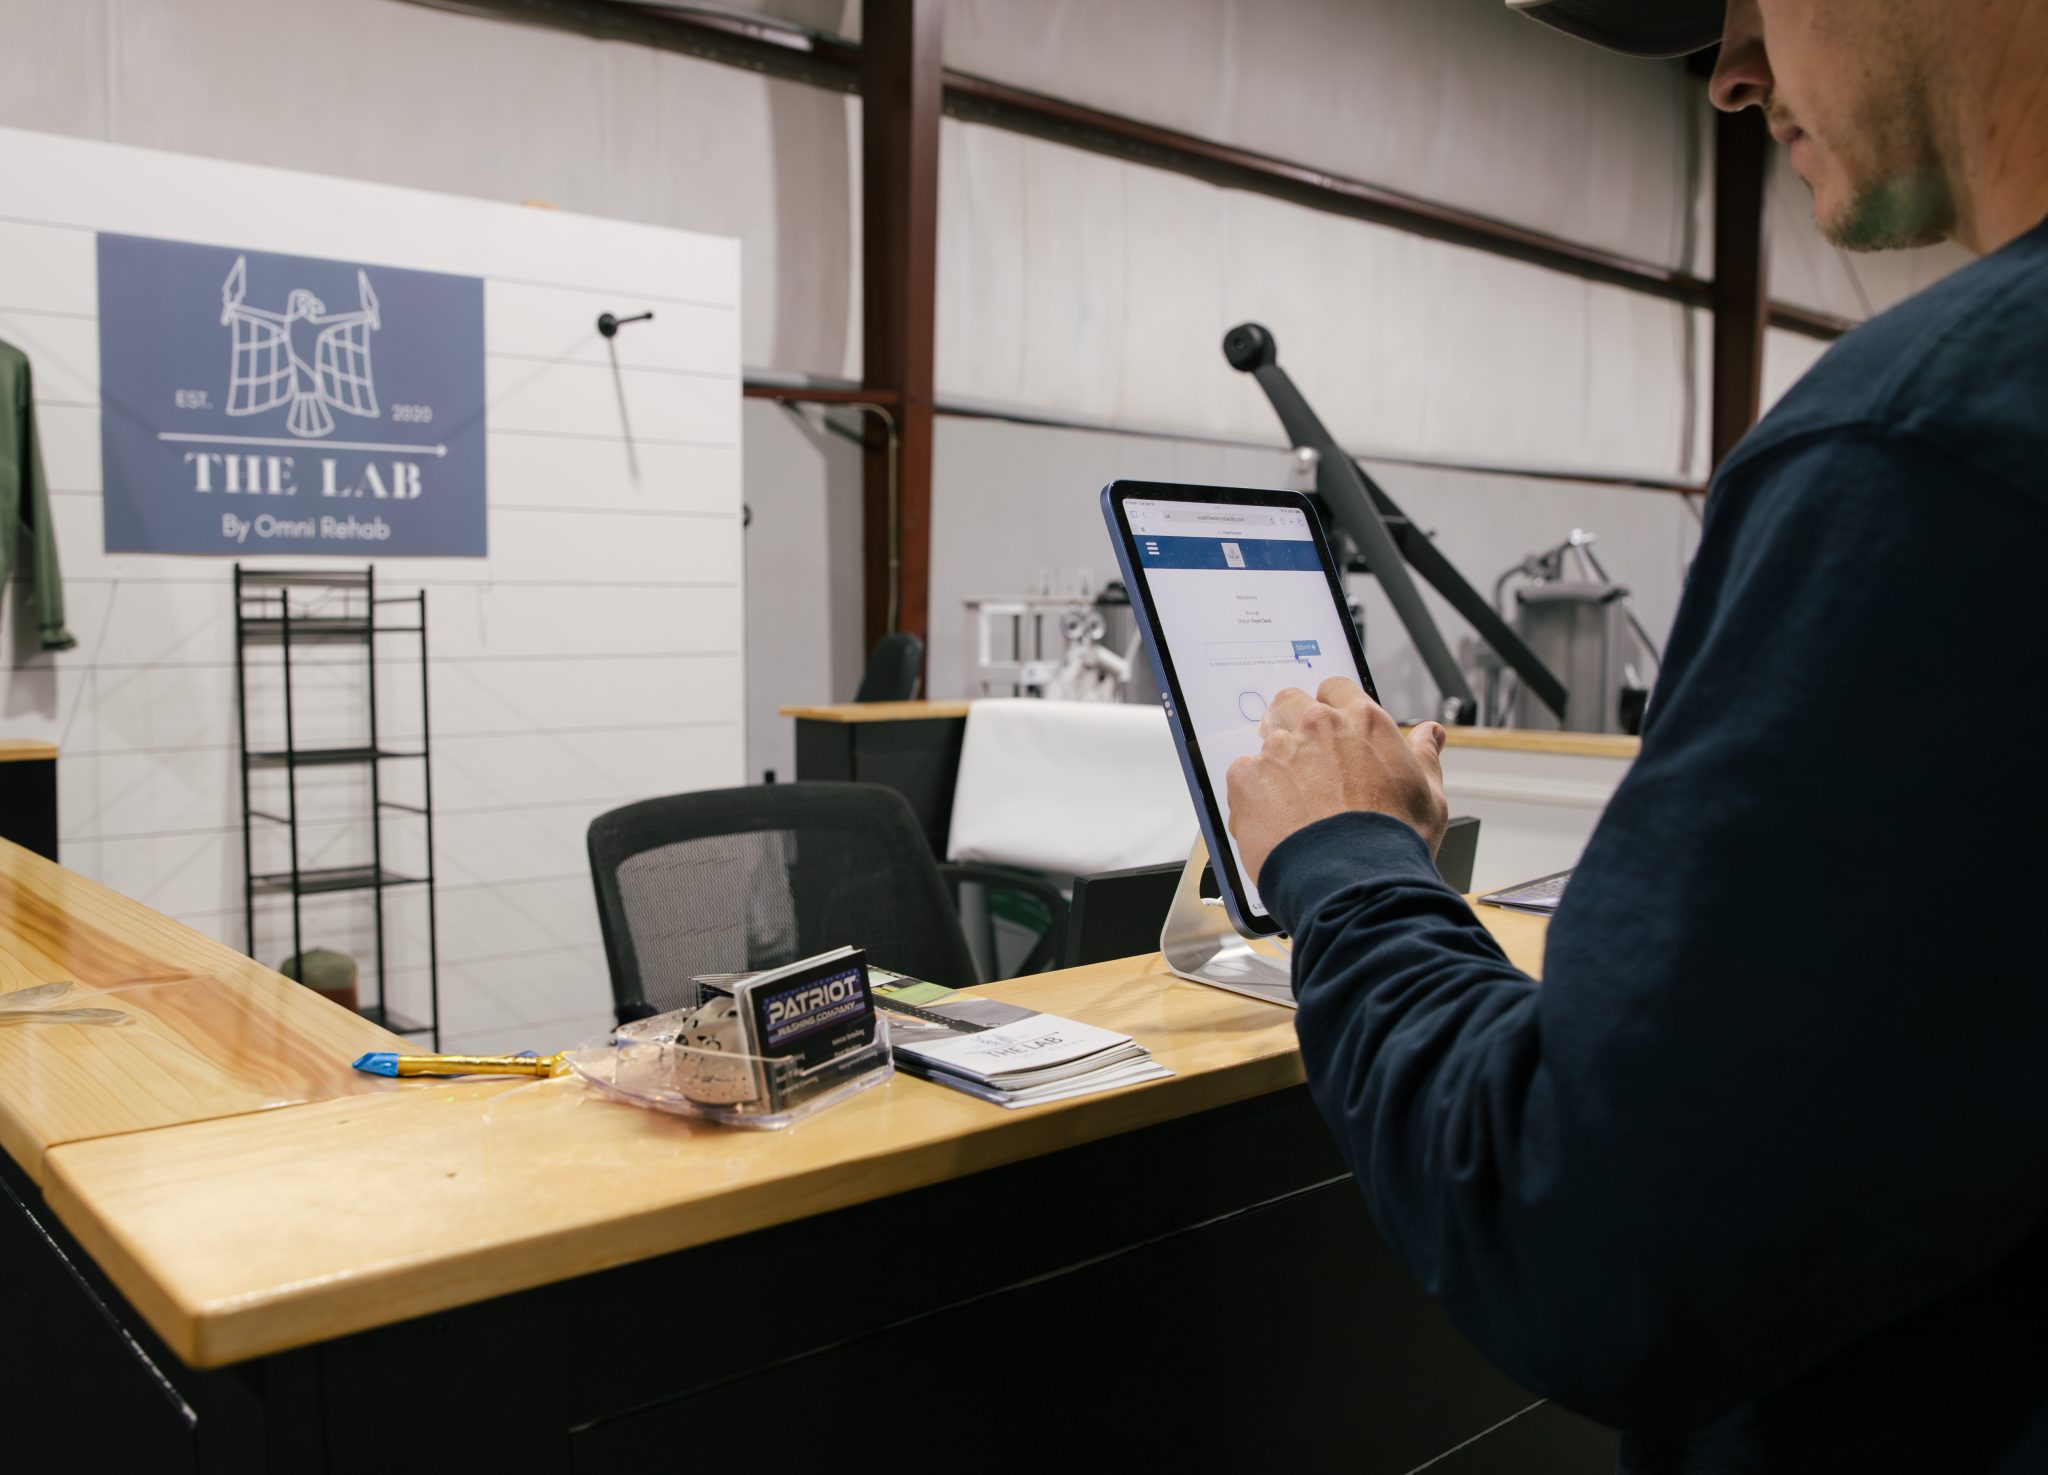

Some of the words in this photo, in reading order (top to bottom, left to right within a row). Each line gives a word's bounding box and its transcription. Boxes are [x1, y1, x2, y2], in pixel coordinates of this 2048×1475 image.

[174, 389, 213, 410] EST.
[391, 403, 433, 424] 2020
[184, 452, 297, 496] THE
[321, 458, 422, 499] LAB
[222, 513, 250, 543] By
[254, 514, 315, 540] Omni
[320, 515, 391, 541] Rehab
[768, 974, 858, 1026] PATRIOT
[777, 1014, 816, 1037] WASHING
[816, 1001, 857, 1023] COMPANY
[986, 1046, 1024, 1058] THE
[1023, 1036, 1063, 1050] LAB
